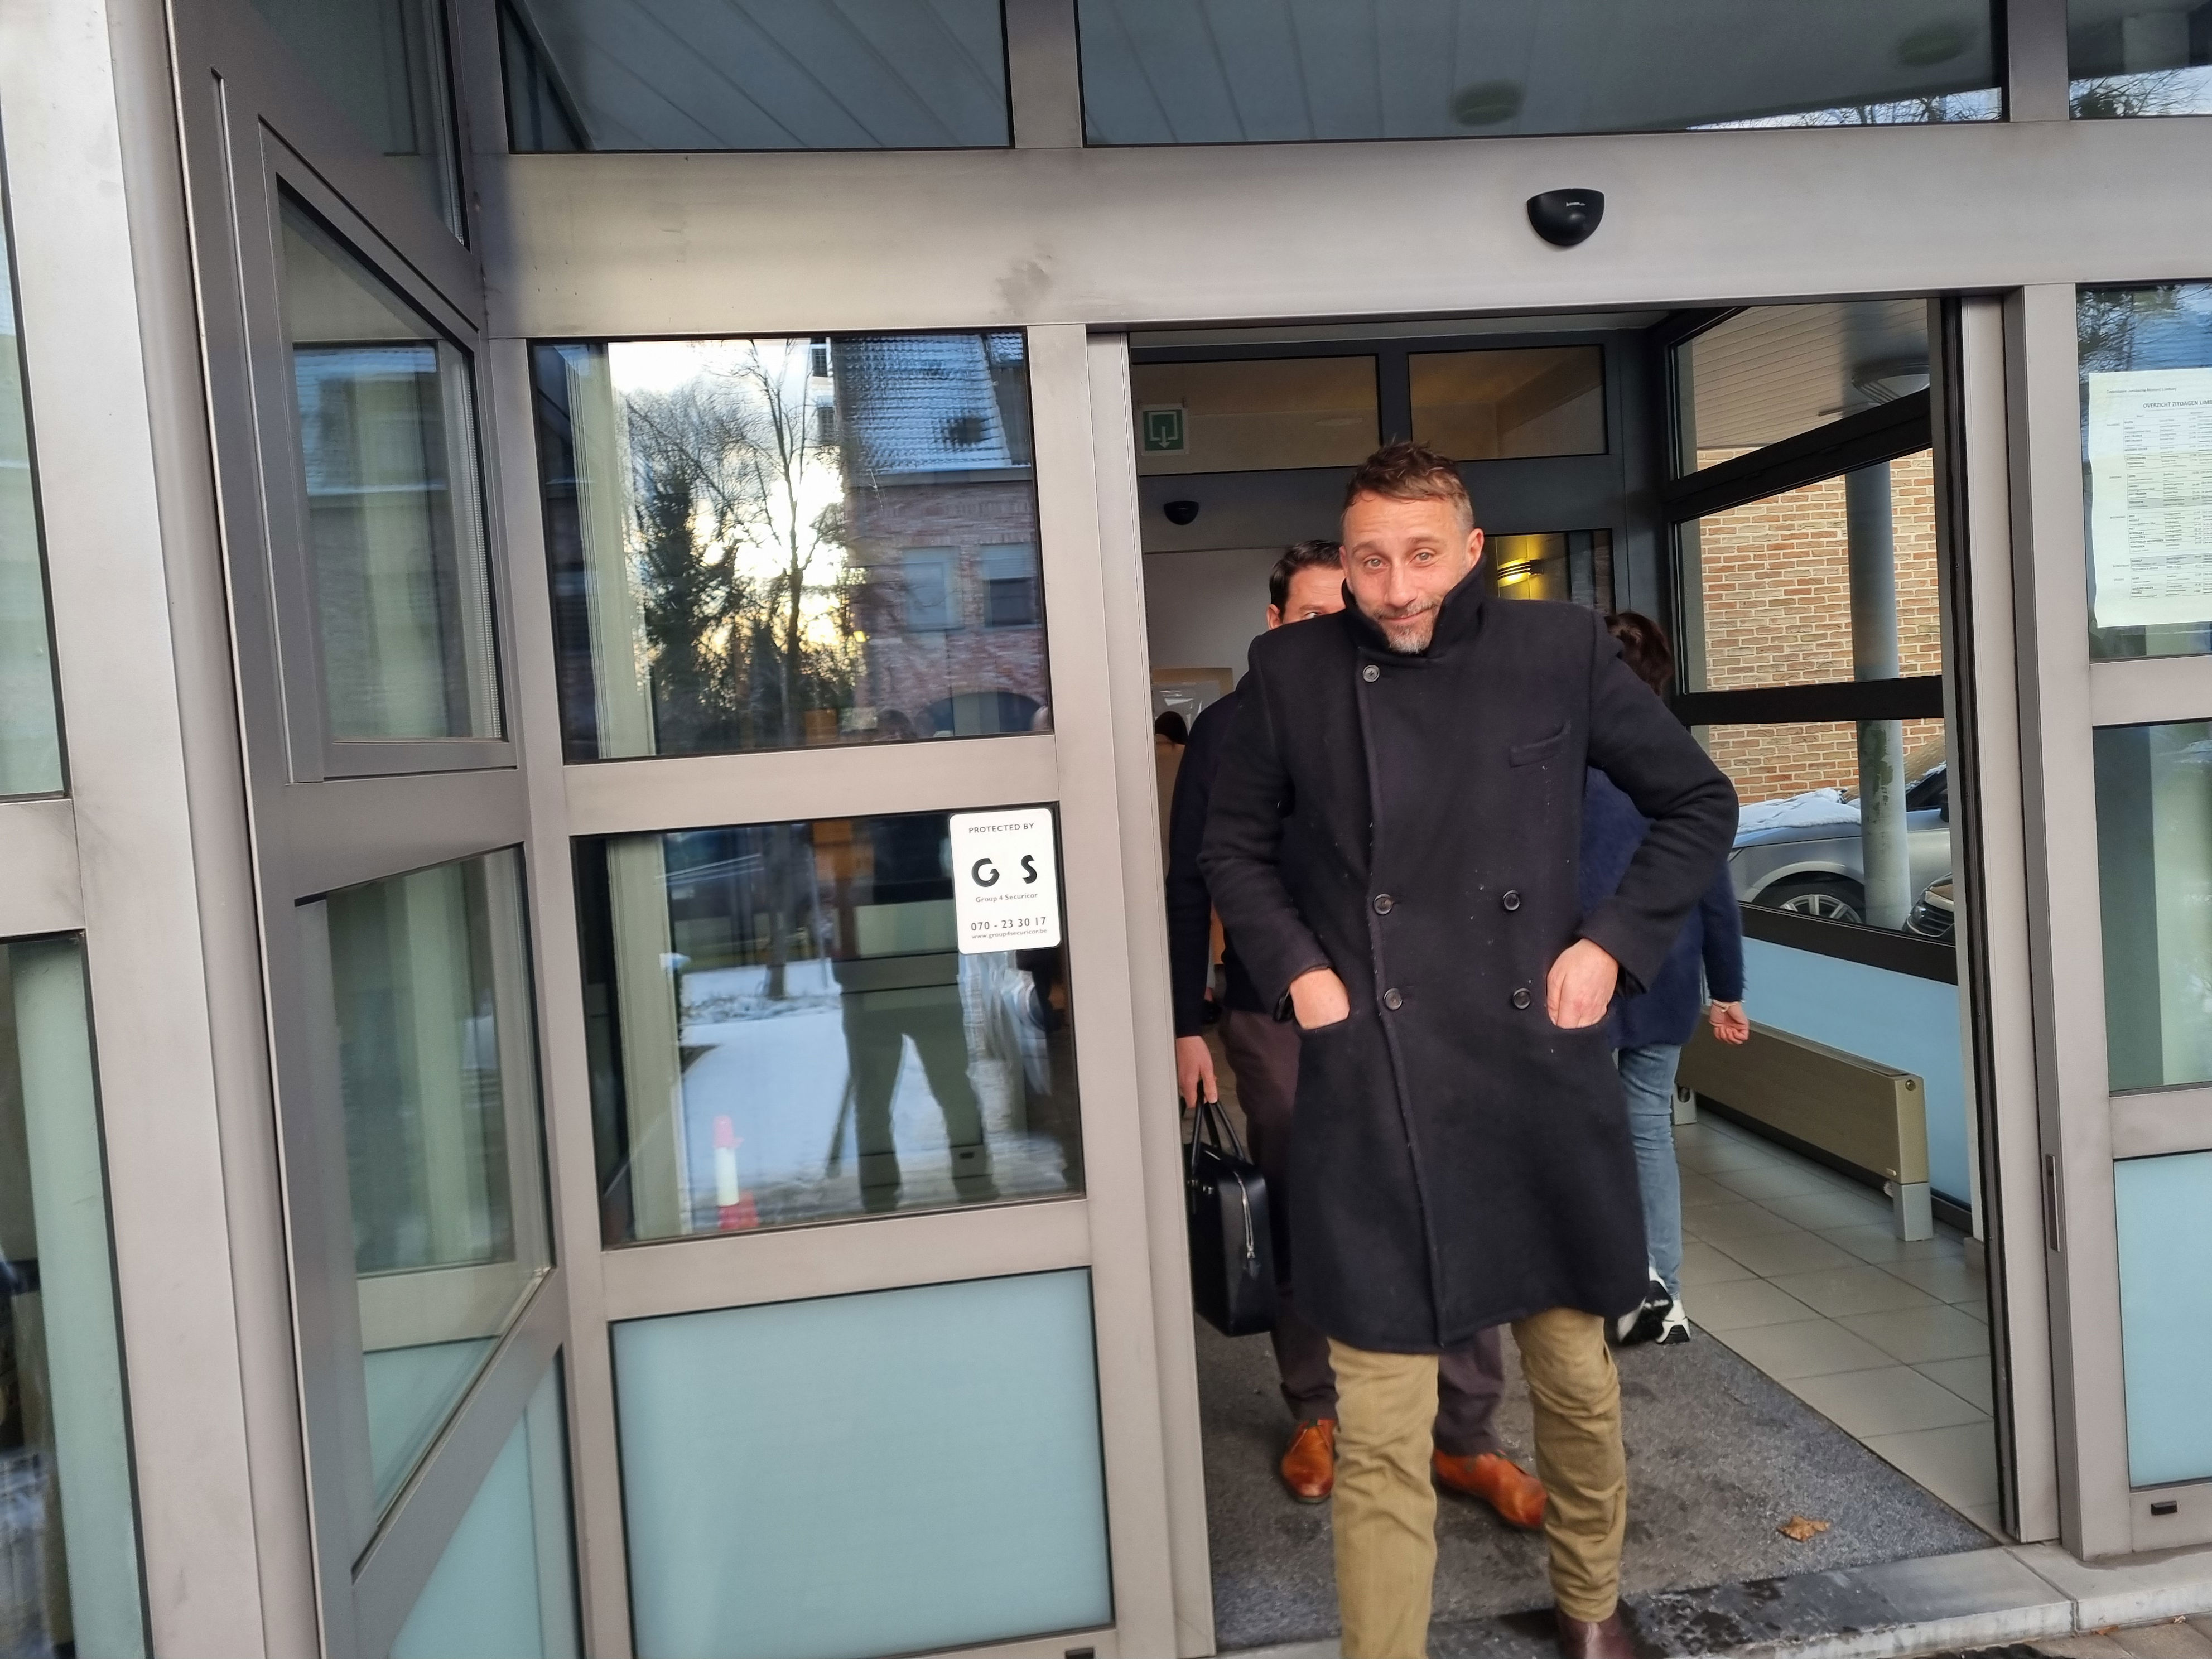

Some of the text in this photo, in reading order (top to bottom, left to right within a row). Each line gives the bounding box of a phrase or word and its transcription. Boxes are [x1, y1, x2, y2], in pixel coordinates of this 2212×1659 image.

[968, 824, 1020, 833] PROTECTED
[1004, 893, 1038, 901] Securicor
[971, 922, 990, 931] 070
[1001, 919, 1014, 928] 23
[1017, 918, 1030, 927] 30
[1035, 916, 1047, 926] 17
[971, 928, 1048, 939] www.group4securicor.be
